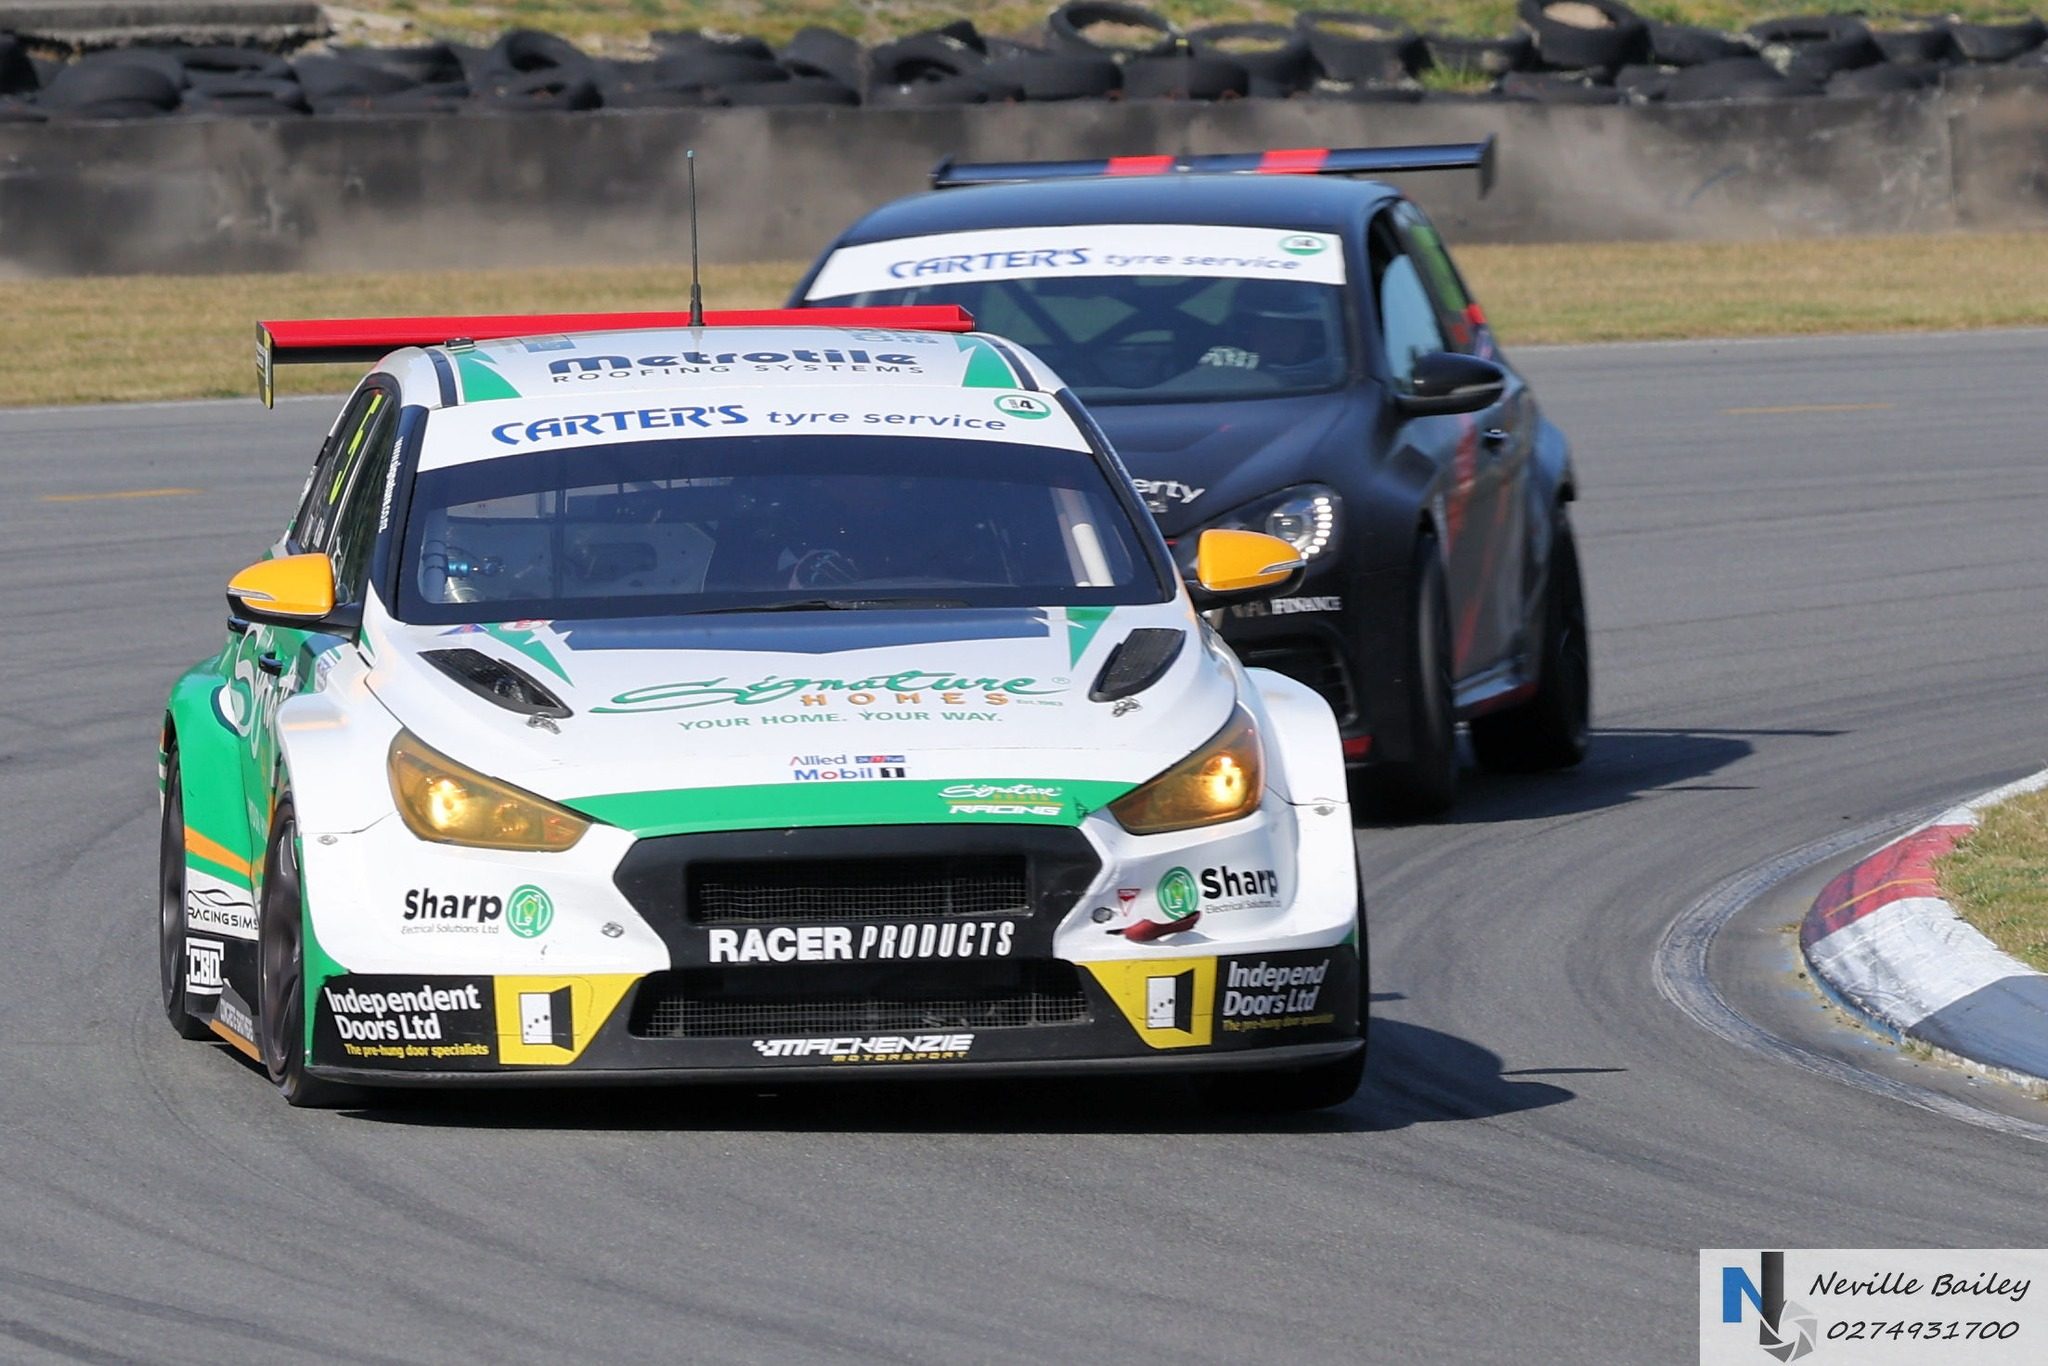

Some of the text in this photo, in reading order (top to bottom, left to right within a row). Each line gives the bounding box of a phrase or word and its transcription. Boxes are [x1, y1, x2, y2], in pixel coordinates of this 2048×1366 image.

[889, 248, 1299, 279] CARTER'S tyre service
[548, 349, 918, 375] metrotile
[552, 364, 924, 383] ROOFING SYSTEMS
[491, 404, 1007, 445] CARTER'S tyre service
[588, 670, 1071, 714] Signature
[800, 692, 1009, 707] HOMES
[677, 710, 1004, 731] YOUR HOME. YOUR WAY.
[790, 754, 847, 766] Allied
[795, 768, 873, 781] Mobil
[949, 805, 1061, 816] RACING
[1201, 866, 1280, 900] Sharp
[403, 888, 503, 923] Sharp
[708, 921, 1015, 963] RACER PRODUCTS
[1226, 958, 1330, 993] Independ
[324, 983, 482, 1019] Independent
[1222, 987, 1320, 1018] Doors Ltd
[335, 1012, 442, 1041] Doors Ltd
[344, 1043, 361, 1055] The
[406, 1044, 430, 1056] door
[431, 1044, 490, 1058] specialists
[764, 1034, 975, 1056] MACKENZIE
